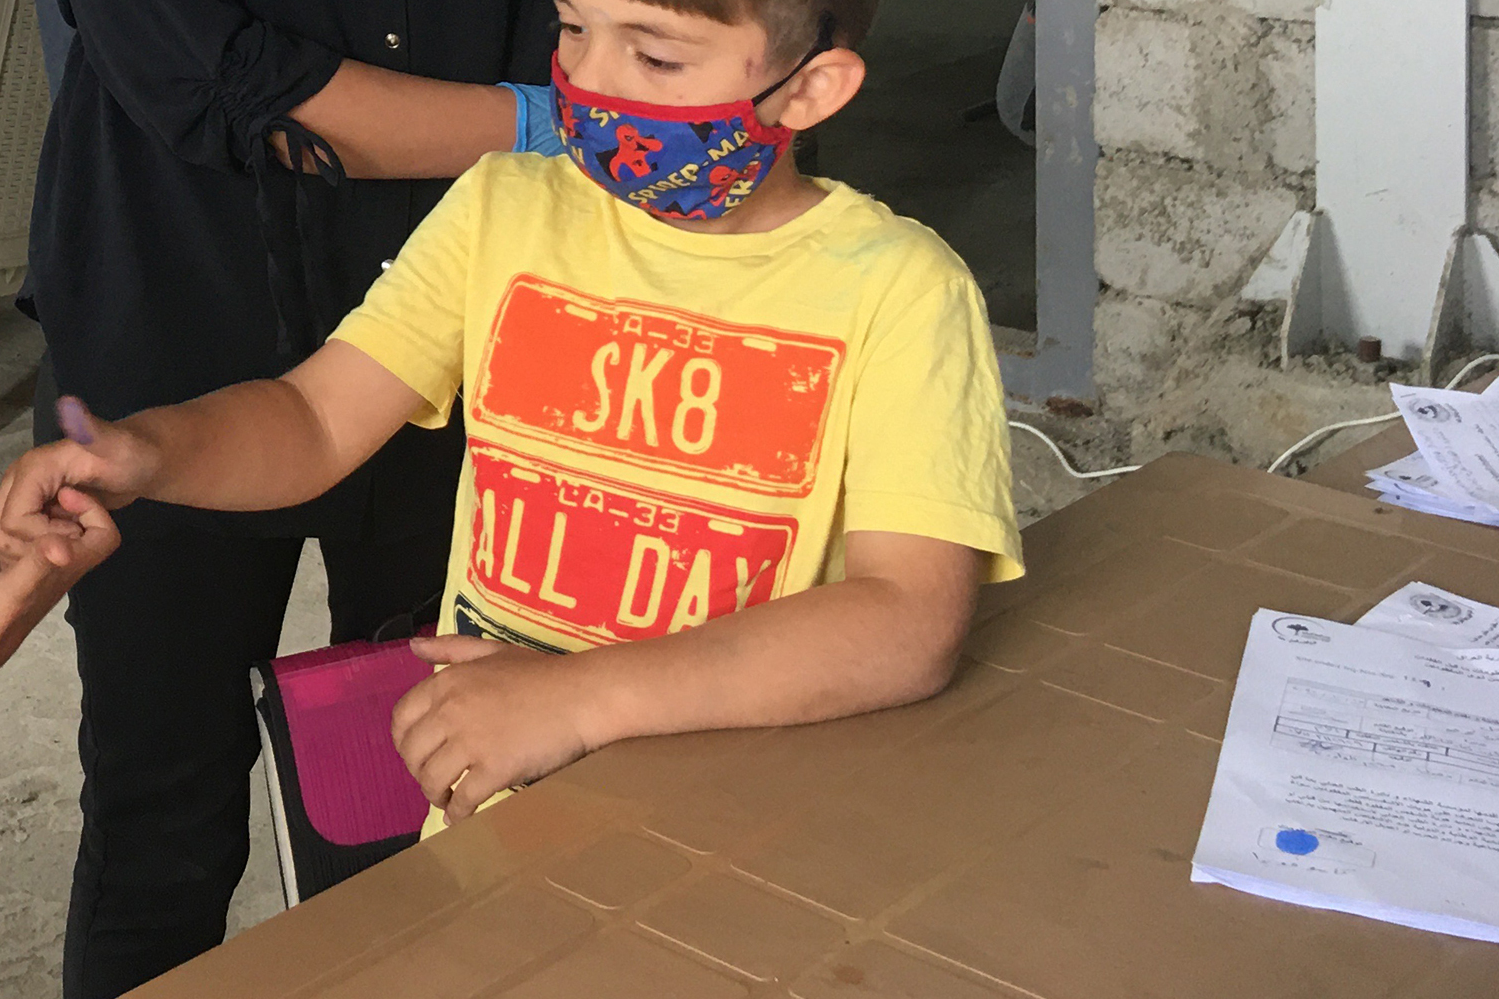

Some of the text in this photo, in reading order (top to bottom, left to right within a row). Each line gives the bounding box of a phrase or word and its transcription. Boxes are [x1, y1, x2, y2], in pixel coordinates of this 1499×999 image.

[628, 129, 750, 204] SPIDER-MA
[612, 312, 715, 355] A-33
[572, 341, 721, 455] SK8
[474, 488, 772, 635] ALL DAY
